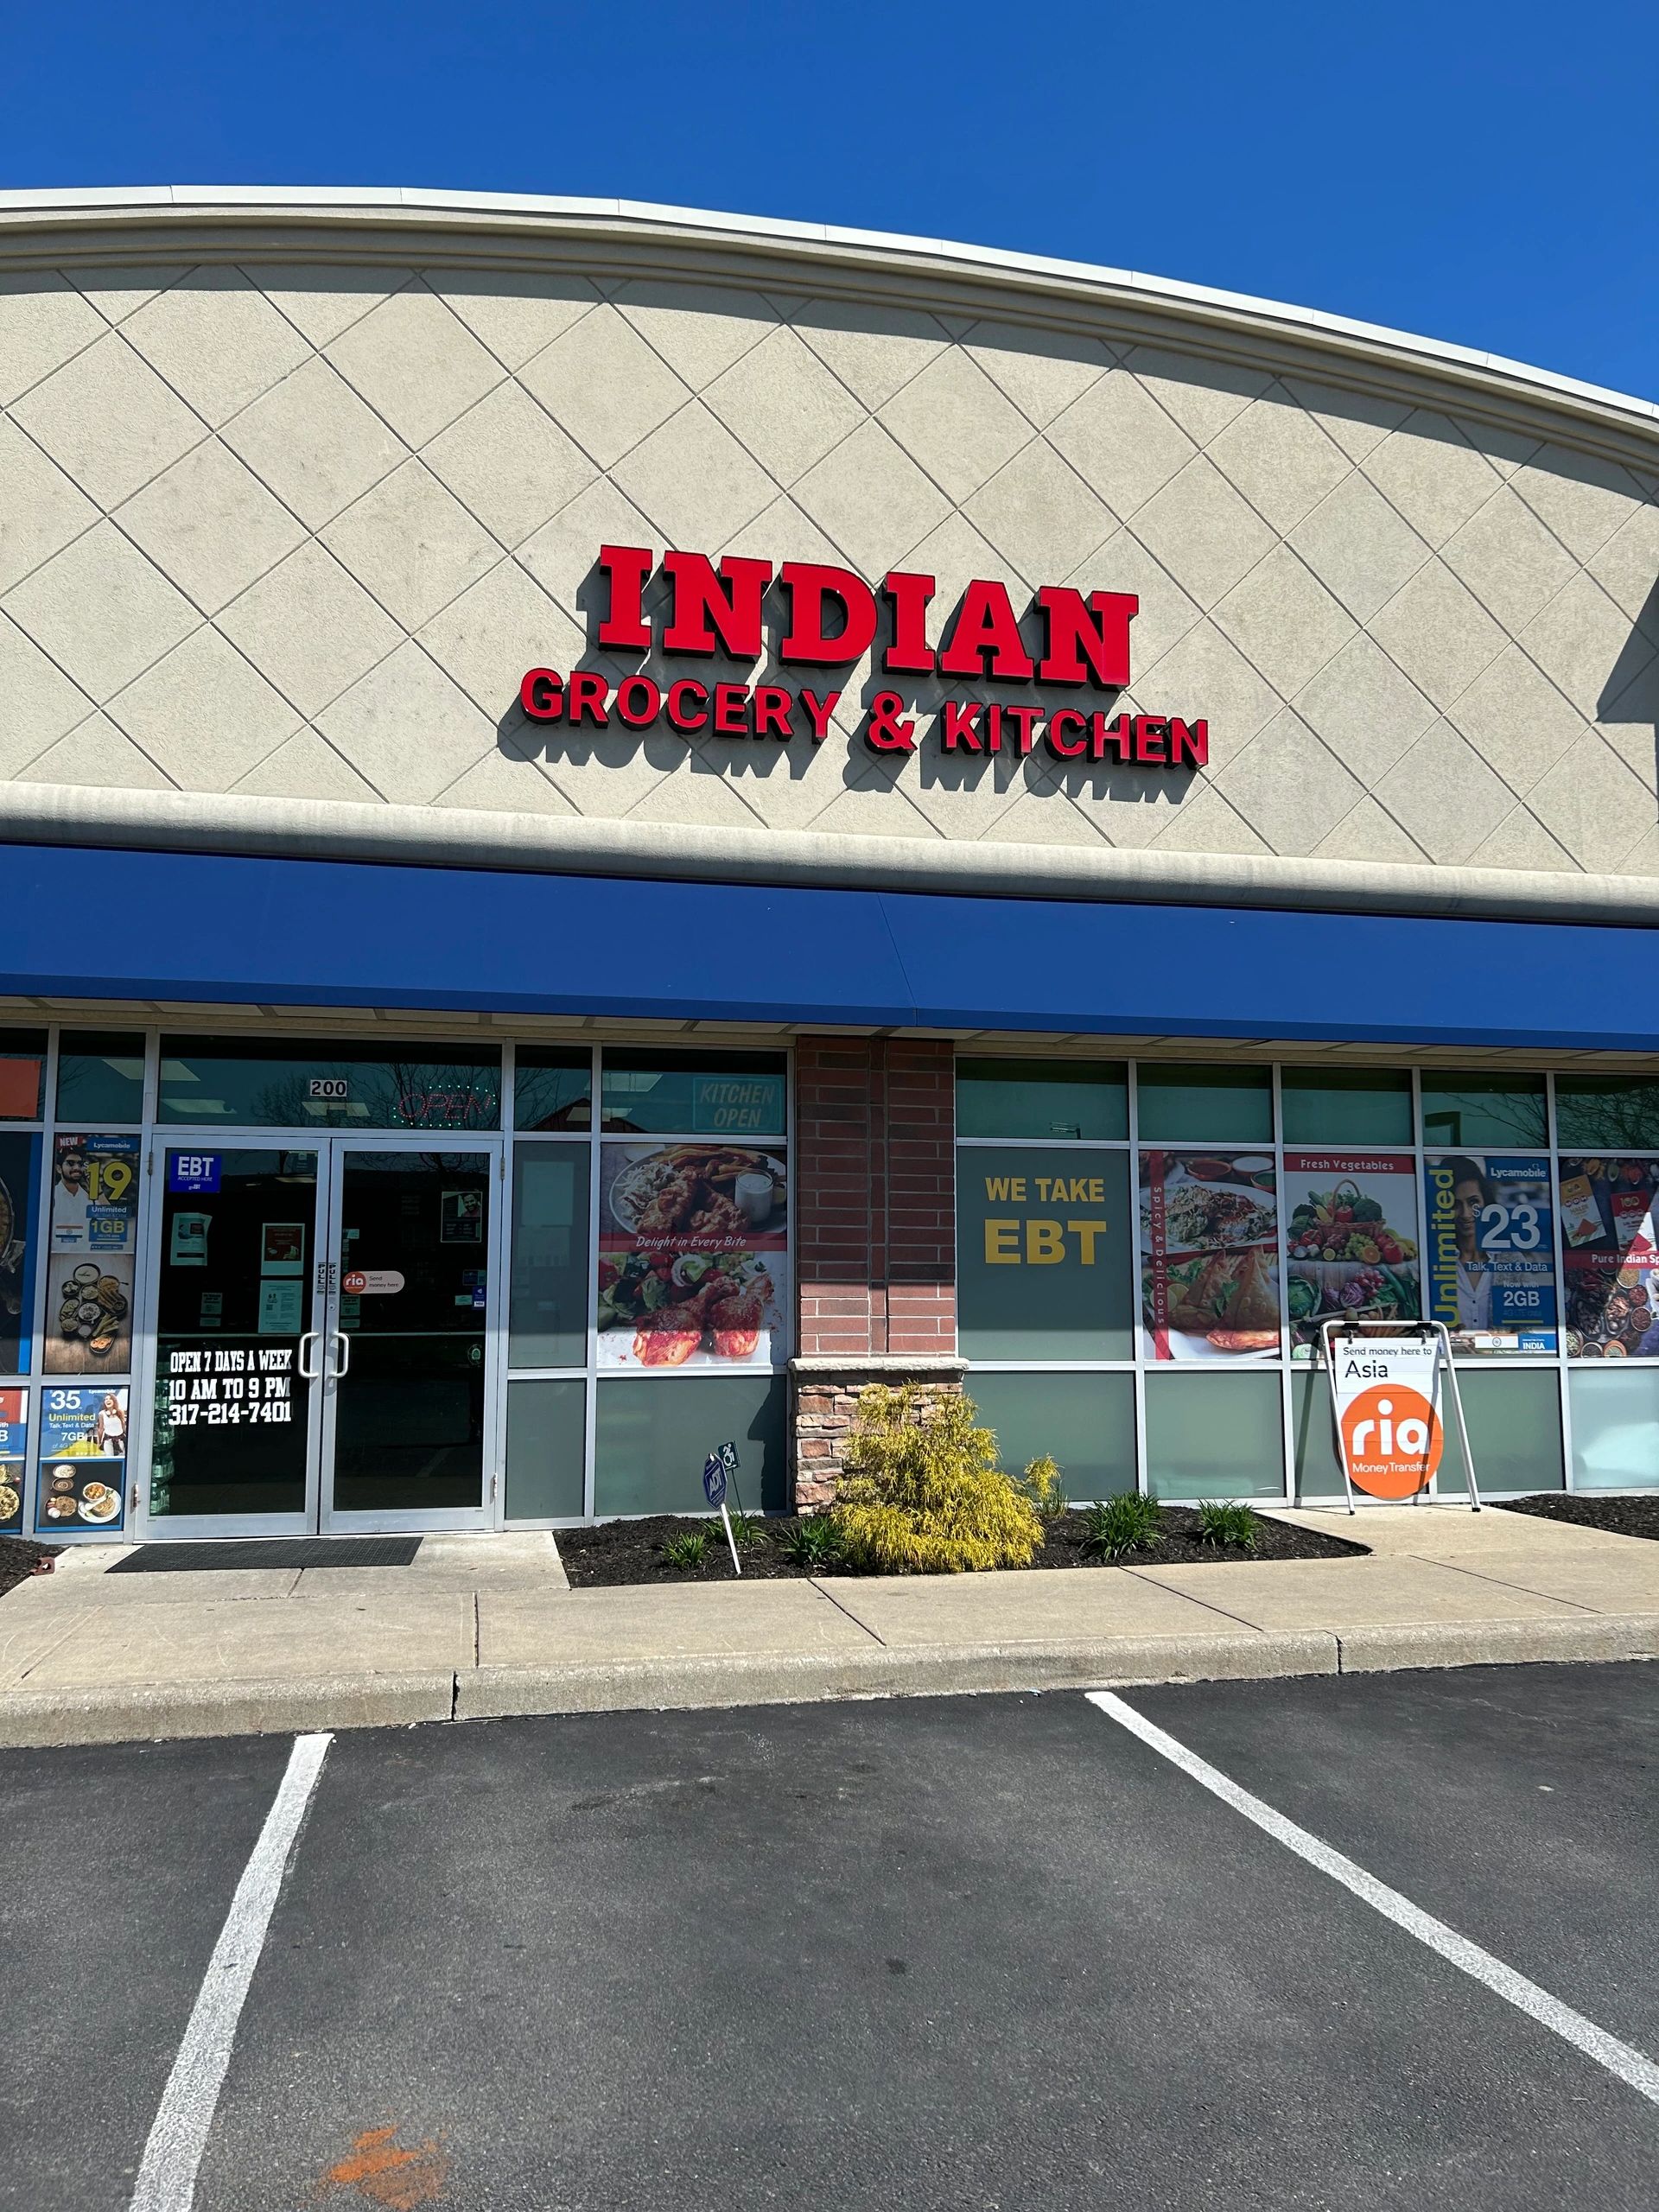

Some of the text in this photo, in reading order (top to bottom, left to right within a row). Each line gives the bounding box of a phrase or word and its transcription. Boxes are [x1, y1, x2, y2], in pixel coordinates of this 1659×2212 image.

[598, 544, 1139, 690] INDIAN
[521, 668, 1208, 769] GROCERY & KITCHEN
[312, 1080, 346, 1096] 200
[700, 1083, 776, 1104] KITCHEN
[399, 1094, 491, 1119] OPEN
[714, 1108, 761, 1128] OPEN
[60, 1137, 79, 1147] NEW
[177, 1156, 214, 1176] EBT
[1300, 1159, 1395, 1172] Fresh Vegetables
[1491, 1167, 1547, 1179] Lycamobile
[985, 1178, 1105, 1202] WE TAKE
[1153, 1186, 1162, 1230] Spicy
[92, 1220, 124, 1234] 1GB
[636, 1236, 747, 1249] Delight in Every Bite
[984, 1218, 1107, 1265] EBT
[1428, 1169, 1461, 1328] Unlimited
[1492, 1262, 1513, 1271] Text
[1515, 1262, 1522, 1271] &
[1525, 1262, 1548, 1271] Data
[1592, 1254, 1614, 1263] Pure
[1617, 1254, 1647, 1263] Indian
[346, 1274, 363, 1286] ria
[1155, 1249, 1165, 1324] Delicious
[1503, 1291, 1541, 1306] 2GB
[170, 1350, 292, 1372] OPEN 7 DAYS A WEEK
[1369, 1348, 1398, 1357] money
[1344, 1360, 1389, 1378] Asia
[168, 1376, 290, 1400] 10 AM TO 9 PM
[168, 1401, 291, 1426] 317-214-7401
[61, 1432, 85, 1440] 7GB
[1352, 1399, 1431, 1456] ria
[1352, 1462, 1430, 1475] Money Transfer
[709, 1467, 722, 1497] ADT
